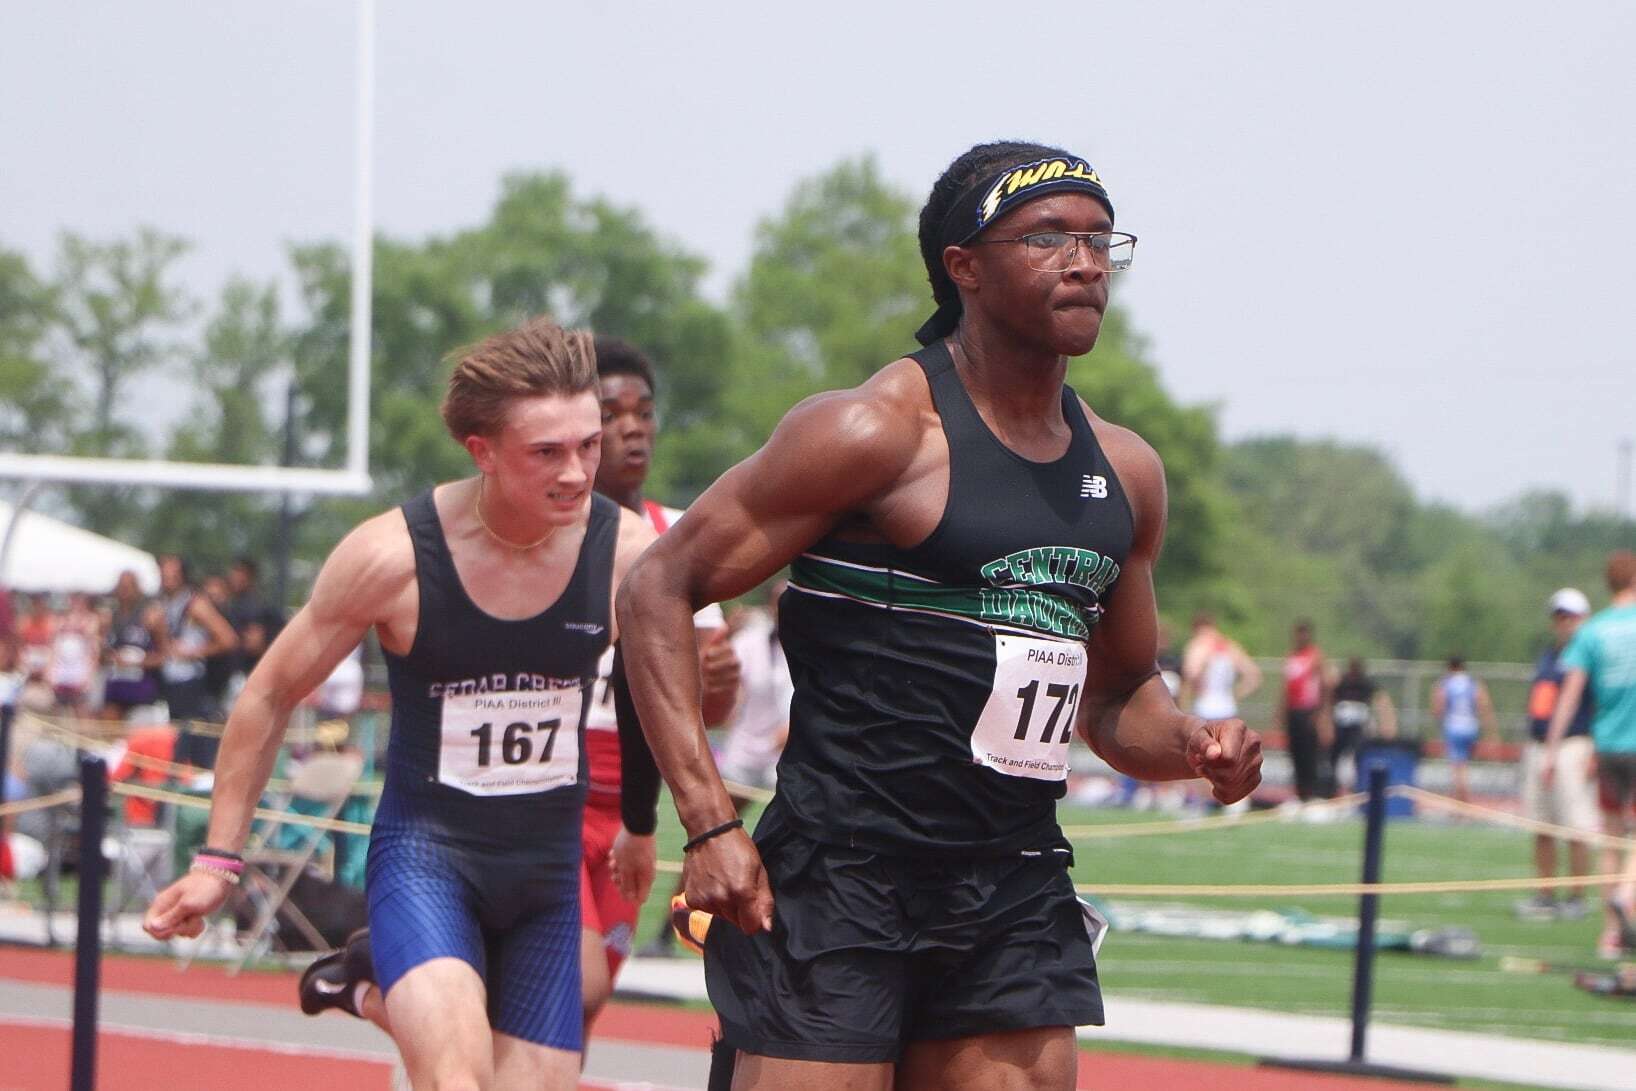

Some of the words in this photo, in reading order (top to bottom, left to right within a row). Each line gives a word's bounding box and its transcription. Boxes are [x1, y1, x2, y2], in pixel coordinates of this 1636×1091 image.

[979, 588, 1090, 640] DAUP
[1027, 649, 1054, 665] PIAA
[474, 698, 506, 709] PIAA
[509, 698, 550, 709] District
[1013, 680, 1079, 744] 172
[470, 718, 562, 767] 167
[986, 753, 1008, 765] Track
[1009, 759, 1024, 768] and
[1024, 760, 1040, 769] Field
